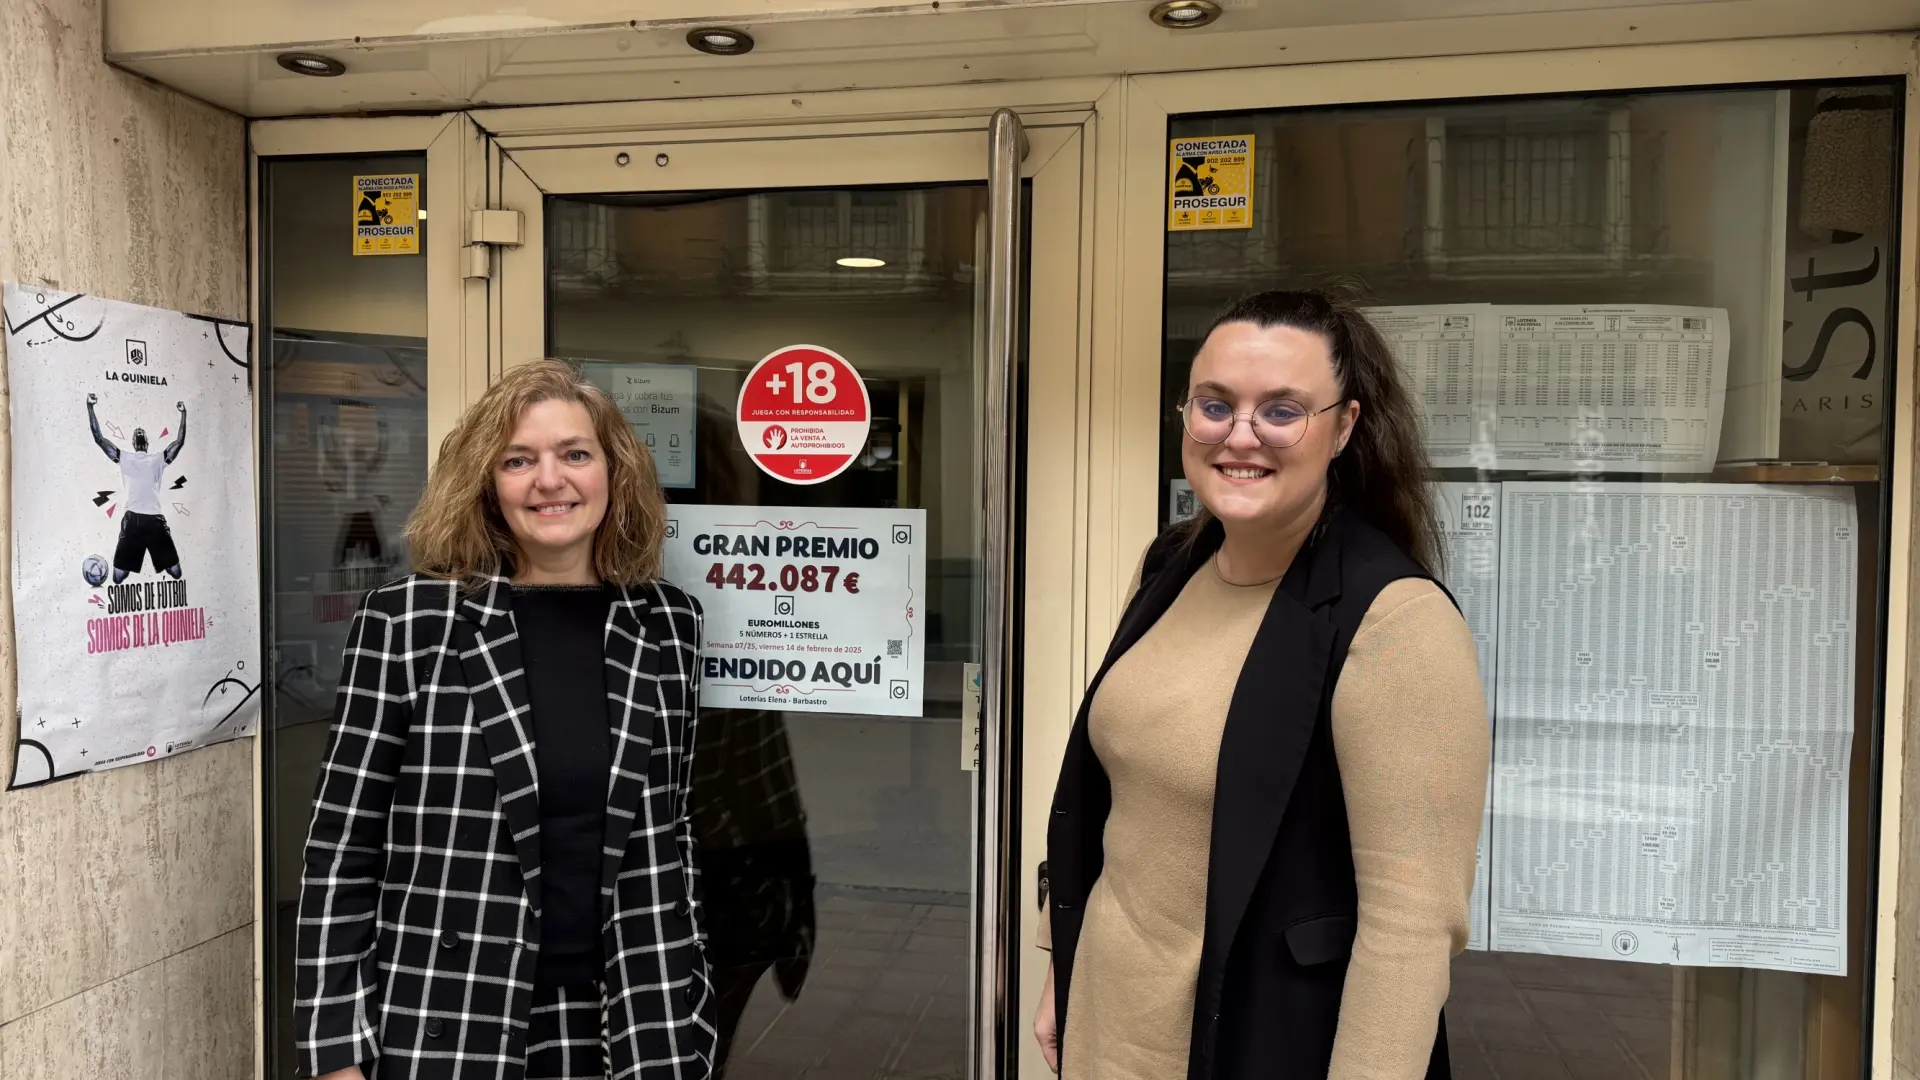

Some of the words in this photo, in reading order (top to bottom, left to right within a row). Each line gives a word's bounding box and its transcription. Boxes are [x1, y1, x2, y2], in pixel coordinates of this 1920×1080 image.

[1176, 140, 1247, 152] CONECTADA
[358, 178, 414, 187] CONECTADA
[1174, 196, 1246, 209] PROSEGUR
[358, 226, 414, 236] PROSEGUR
[106, 371, 119, 381] LA
[122, 373, 168, 386] QUINIELA
[766, 362, 836, 404] +18
[628, 392, 632, 401] y
[634, 392, 658, 400] cobra
[660, 392, 674, 400] tus
[1782, 393, 1873, 412] ARIS
[633, 406, 648, 414] con
[651, 404, 680, 414] Bizum
[1466, 505, 1491, 518] 102
[693, 534, 770, 557] GRAN
[775, 537, 880, 560] PREMIO
[108, 583, 142, 614] SOMOS
[144, 582, 155, 610] DE
[157, 576, 188, 609] FÚTBOL
[748, 619, 820, 629] EUROMILLONES
[87, 616, 130, 654] SOMOS
[133, 614, 145, 648] DE
[148, 612, 159, 646] LA
[162, 608, 205, 647] QUINIELA
[746, 630, 782, 639] NÚMEROS
[796, 632, 828, 640] ESTRELLA
[707, 642, 734, 650] Semana
[735, 642, 758, 651] 07/25,
[796, 644, 805, 652] de
[806, 644, 832, 652] febrero
[834, 645, 843, 653] de
[844, 646, 862, 654] 2025
[811, 655, 882, 688] AQUÍ
[739, 695, 767, 703] Loterías
[768, 696, 787, 704] Elena
[792, 698, 828, 706] Barbastro
